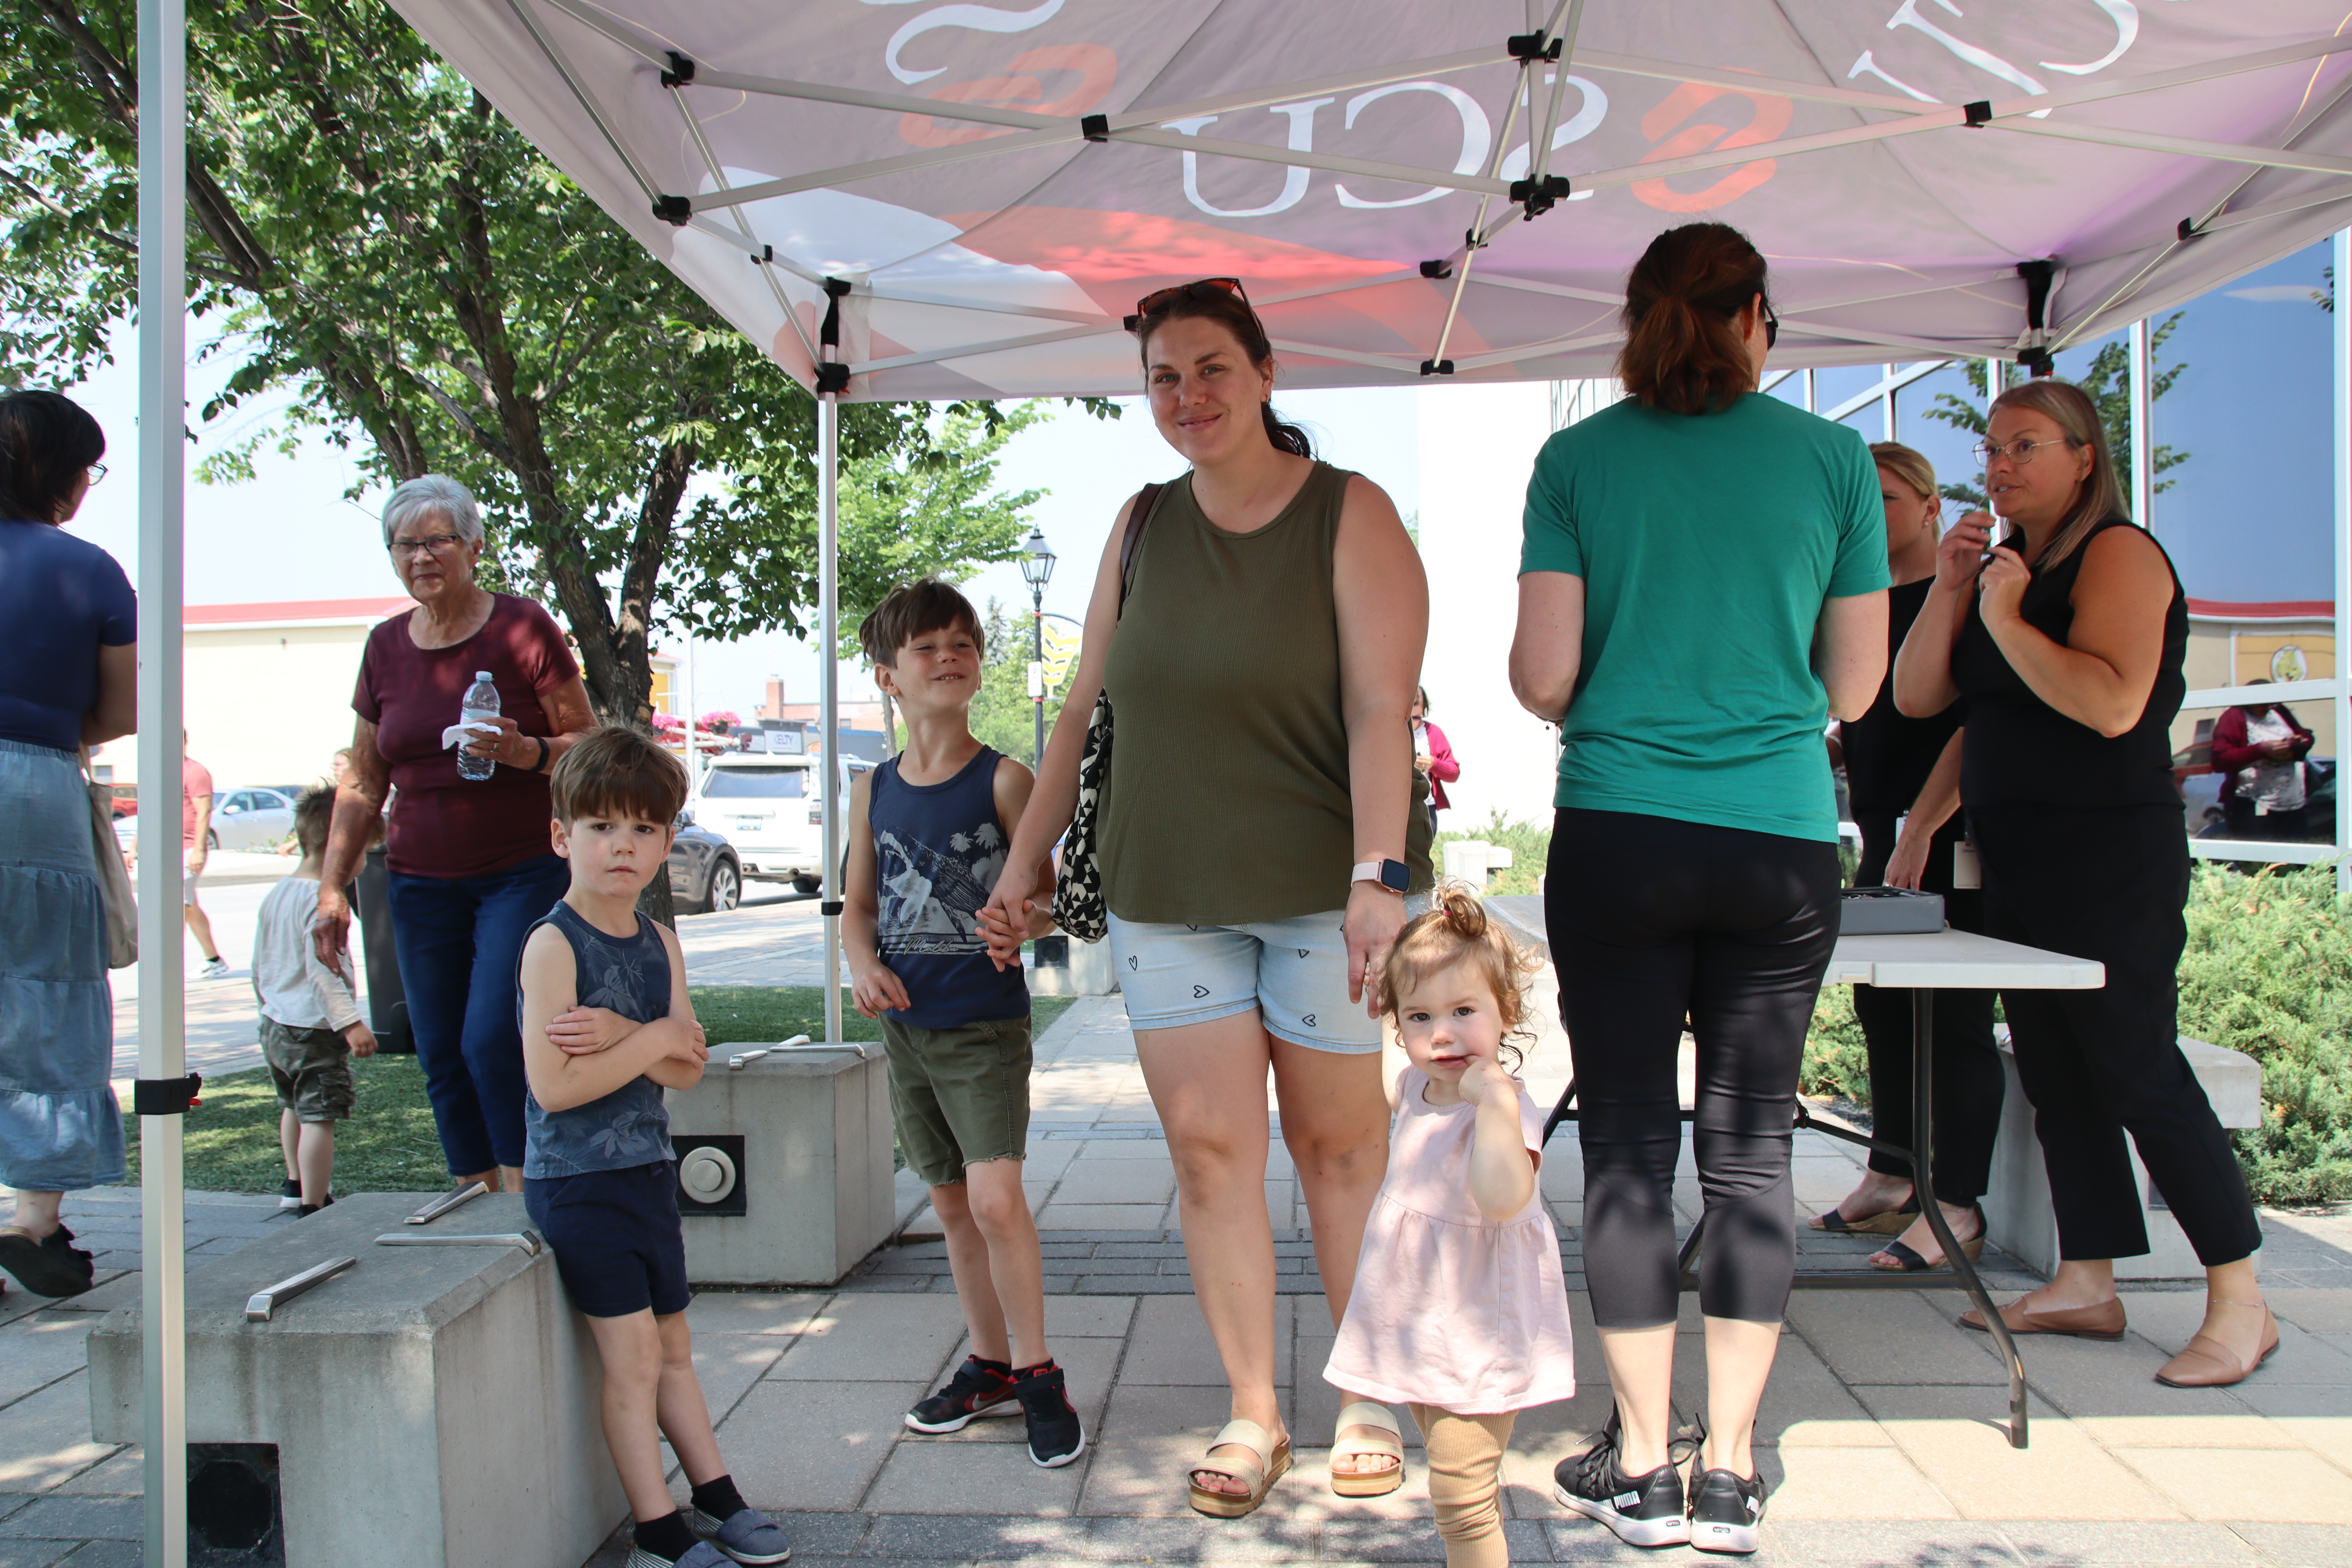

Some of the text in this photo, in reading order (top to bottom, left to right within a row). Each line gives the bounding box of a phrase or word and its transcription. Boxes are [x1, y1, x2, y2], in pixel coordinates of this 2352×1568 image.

[1033, 668, 1037, 676] P
[903, 936, 959, 955] Malibu
[1613, 1490, 1641, 1510] PUMA
[1746, 1495, 1759, 1514] PU
